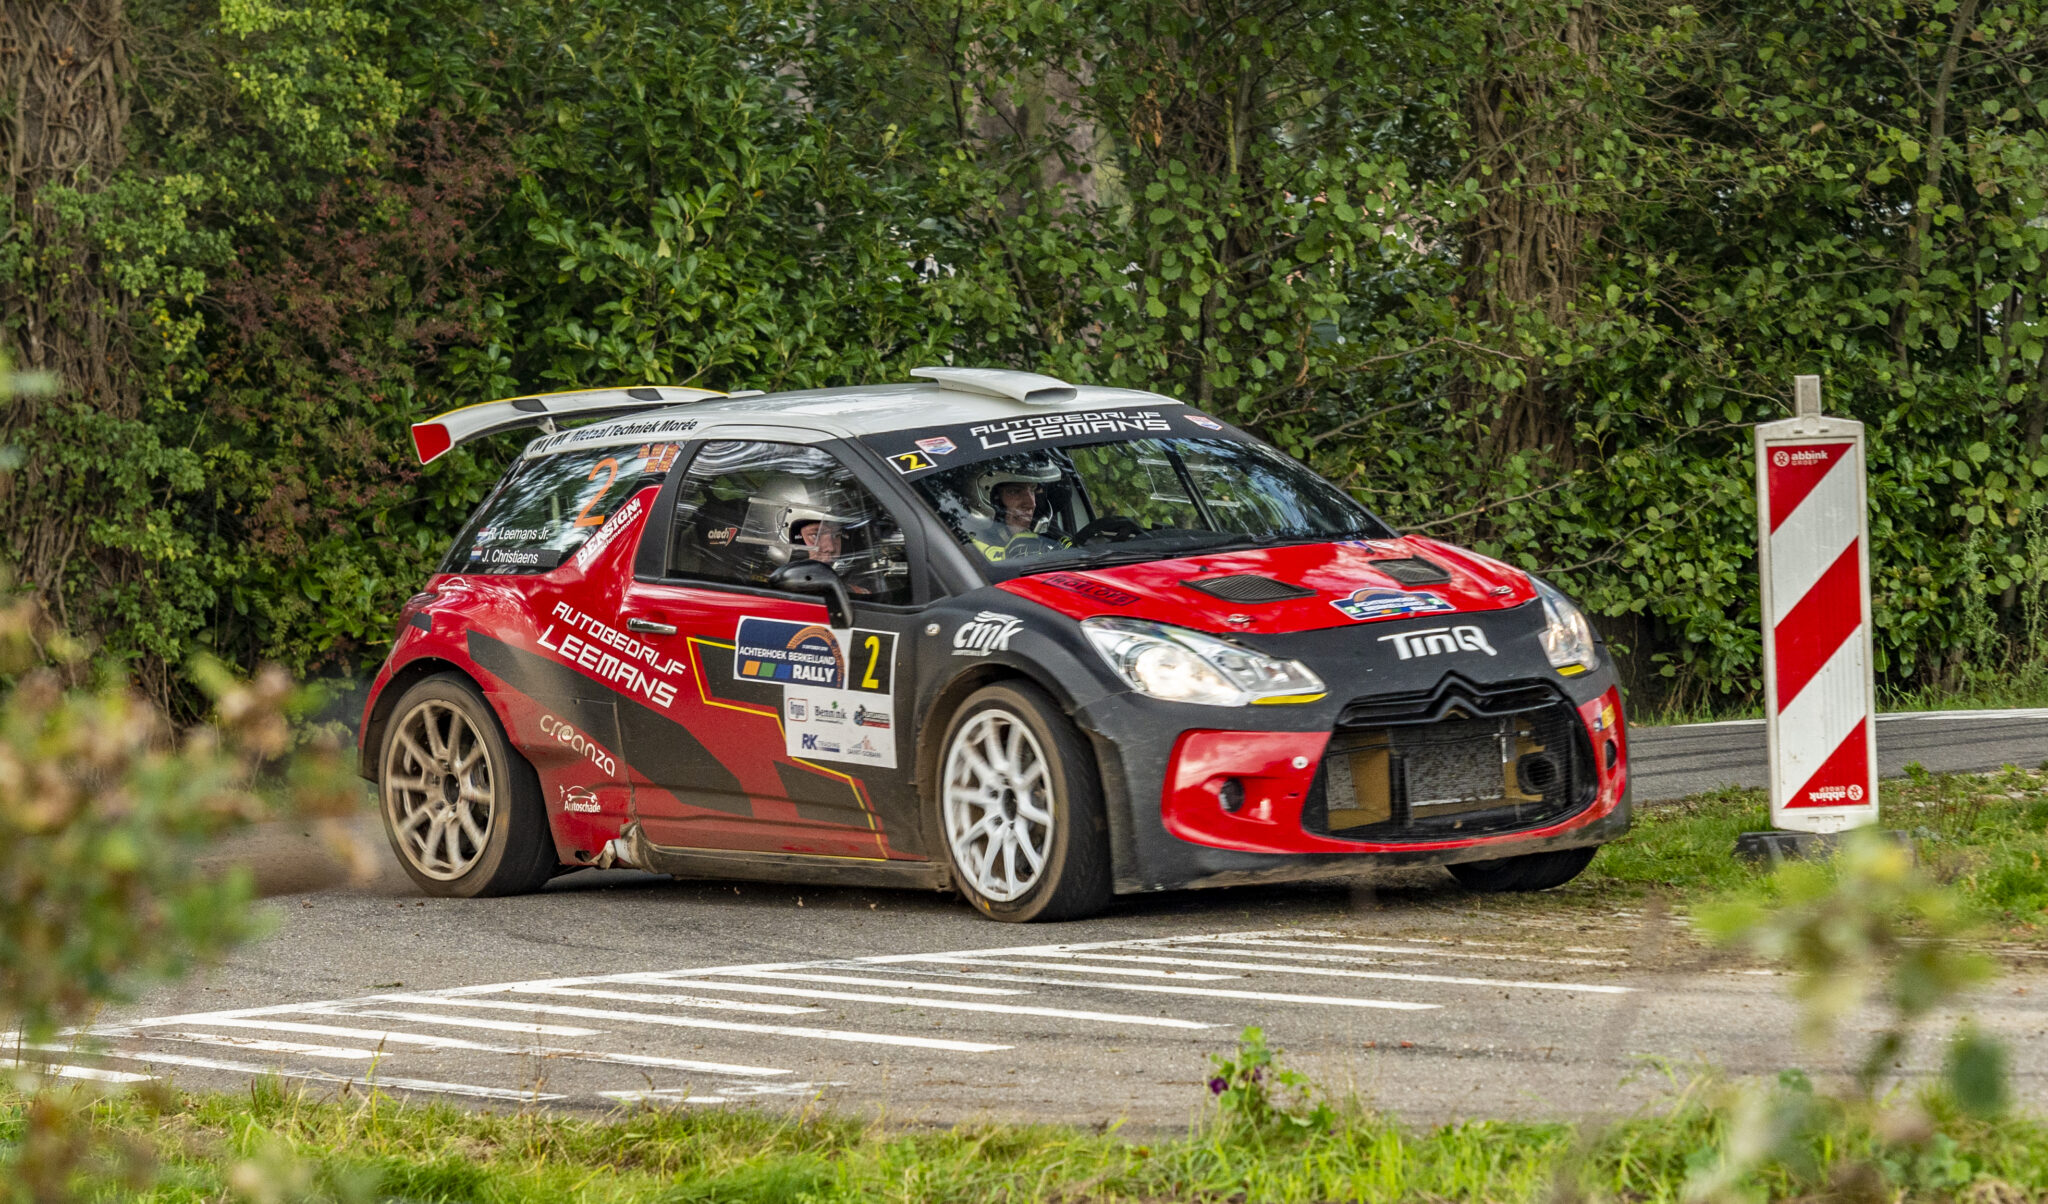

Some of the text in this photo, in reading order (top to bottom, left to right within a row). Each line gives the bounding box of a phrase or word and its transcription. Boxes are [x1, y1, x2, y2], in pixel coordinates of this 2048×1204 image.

[570, 425, 611, 442] Metaal
[609, 420, 659, 437] Techniek
[658, 418, 699, 432] Morée
[970, 411, 1161, 437] AUTOBEDRIJF
[979, 419, 1172, 450] LEEMANS
[899, 454, 927, 470] 2
[1791, 450, 1829, 460] abbink
[574, 457, 618, 528] 2
[498, 527, 538, 540] Leemans
[538, 527, 549, 540] Jr.
[481, 549, 539, 564] J. Christiaens
[552, 600, 687, 676] AUTOBEDRIJF
[739, 646, 787, 660] ACHTERHOEK
[788, 652, 836, 666] BERKELLAND
[861, 635, 881, 689] 2
[536, 624, 678, 709] LEEMANS
[792, 664, 835, 683] RALLY
[802, 733, 819, 750] RK
[1808, 791, 1846, 802] abbink
